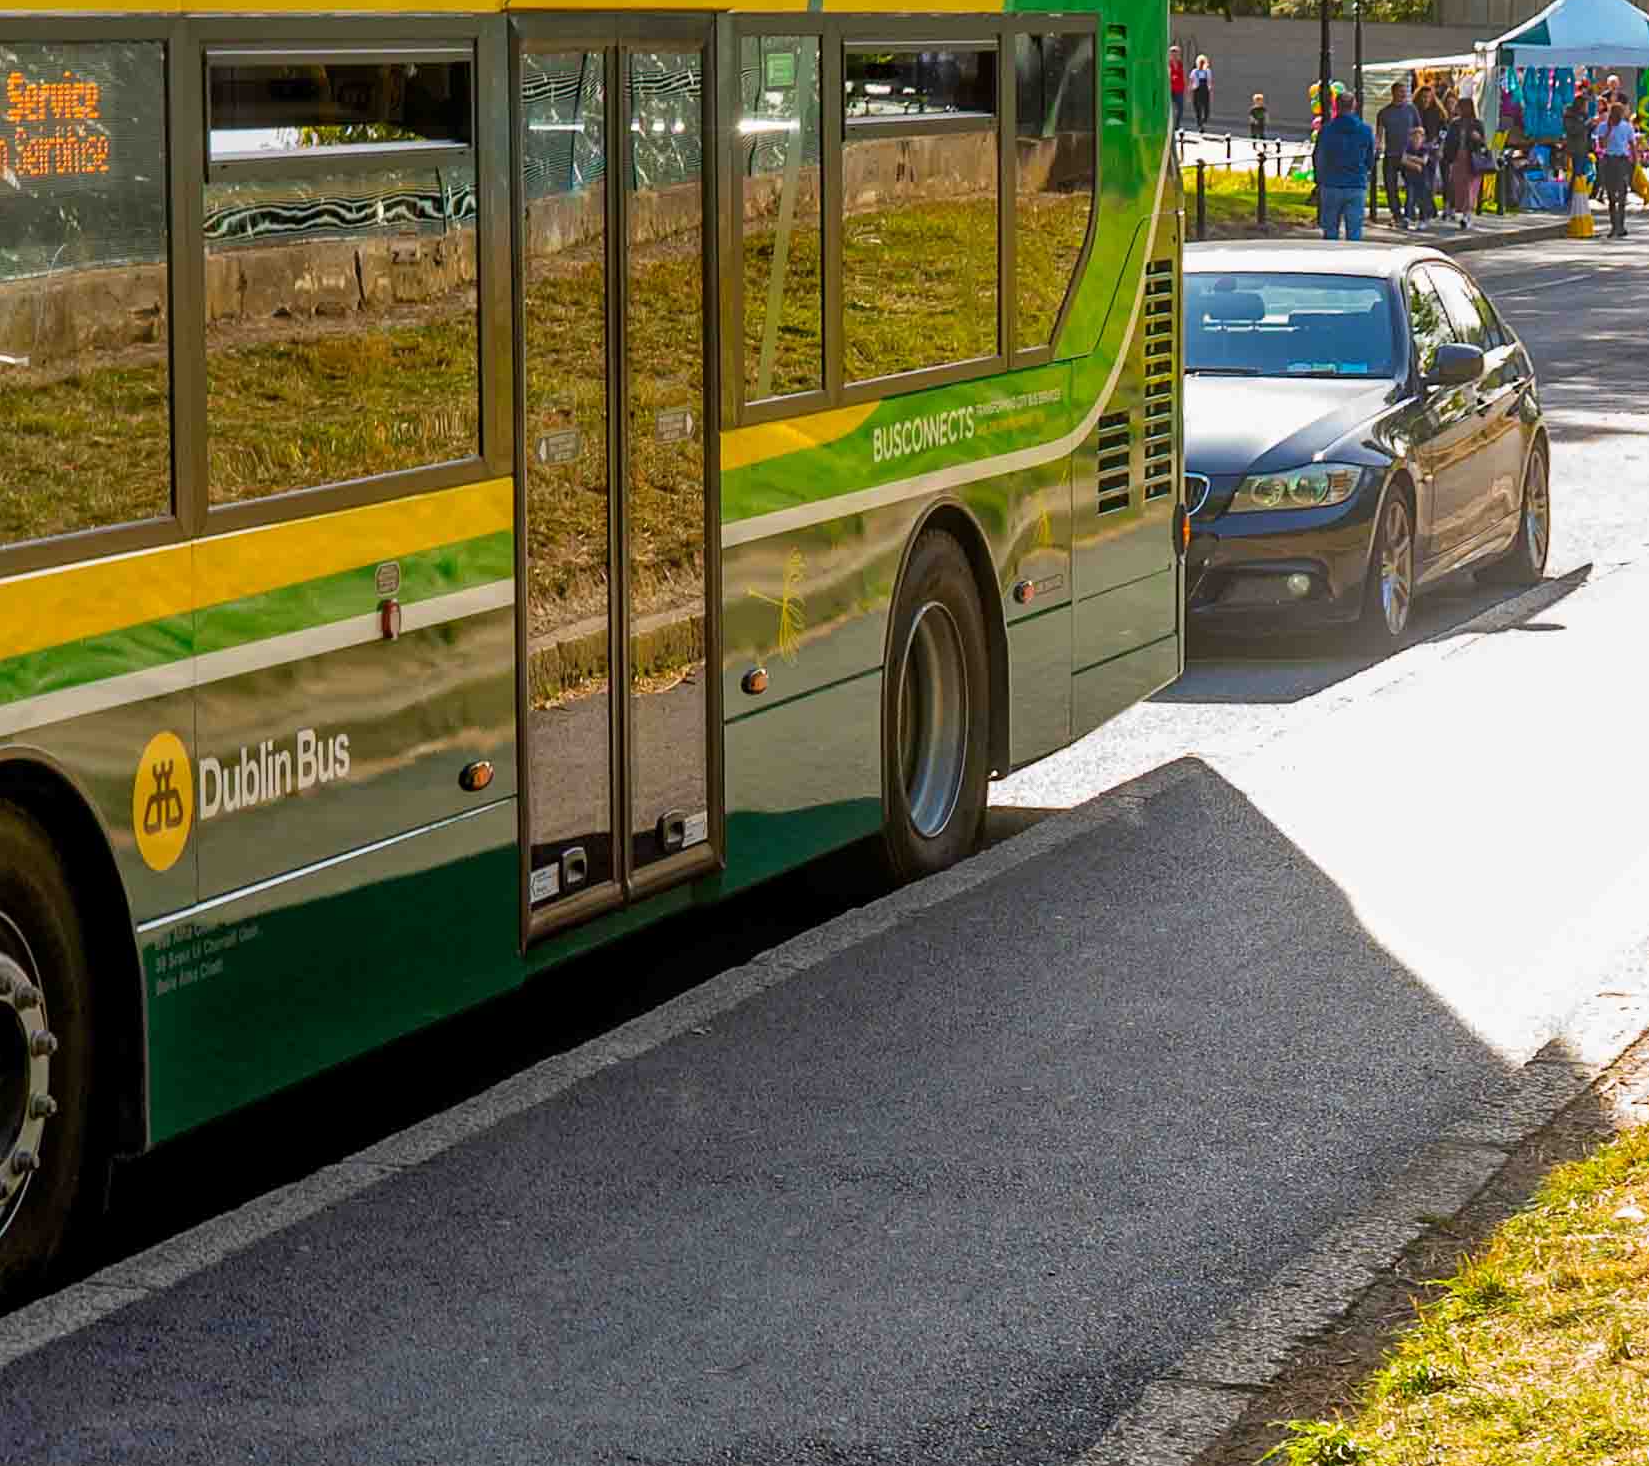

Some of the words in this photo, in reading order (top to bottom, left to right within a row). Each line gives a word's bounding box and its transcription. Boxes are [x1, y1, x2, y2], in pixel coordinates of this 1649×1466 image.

[7, 70, 101, 122] Service
[873, 405, 975, 463] BUSCONNECTS
[199, 739, 292, 821] Dublin
[296, 728, 351, 791] Bus
